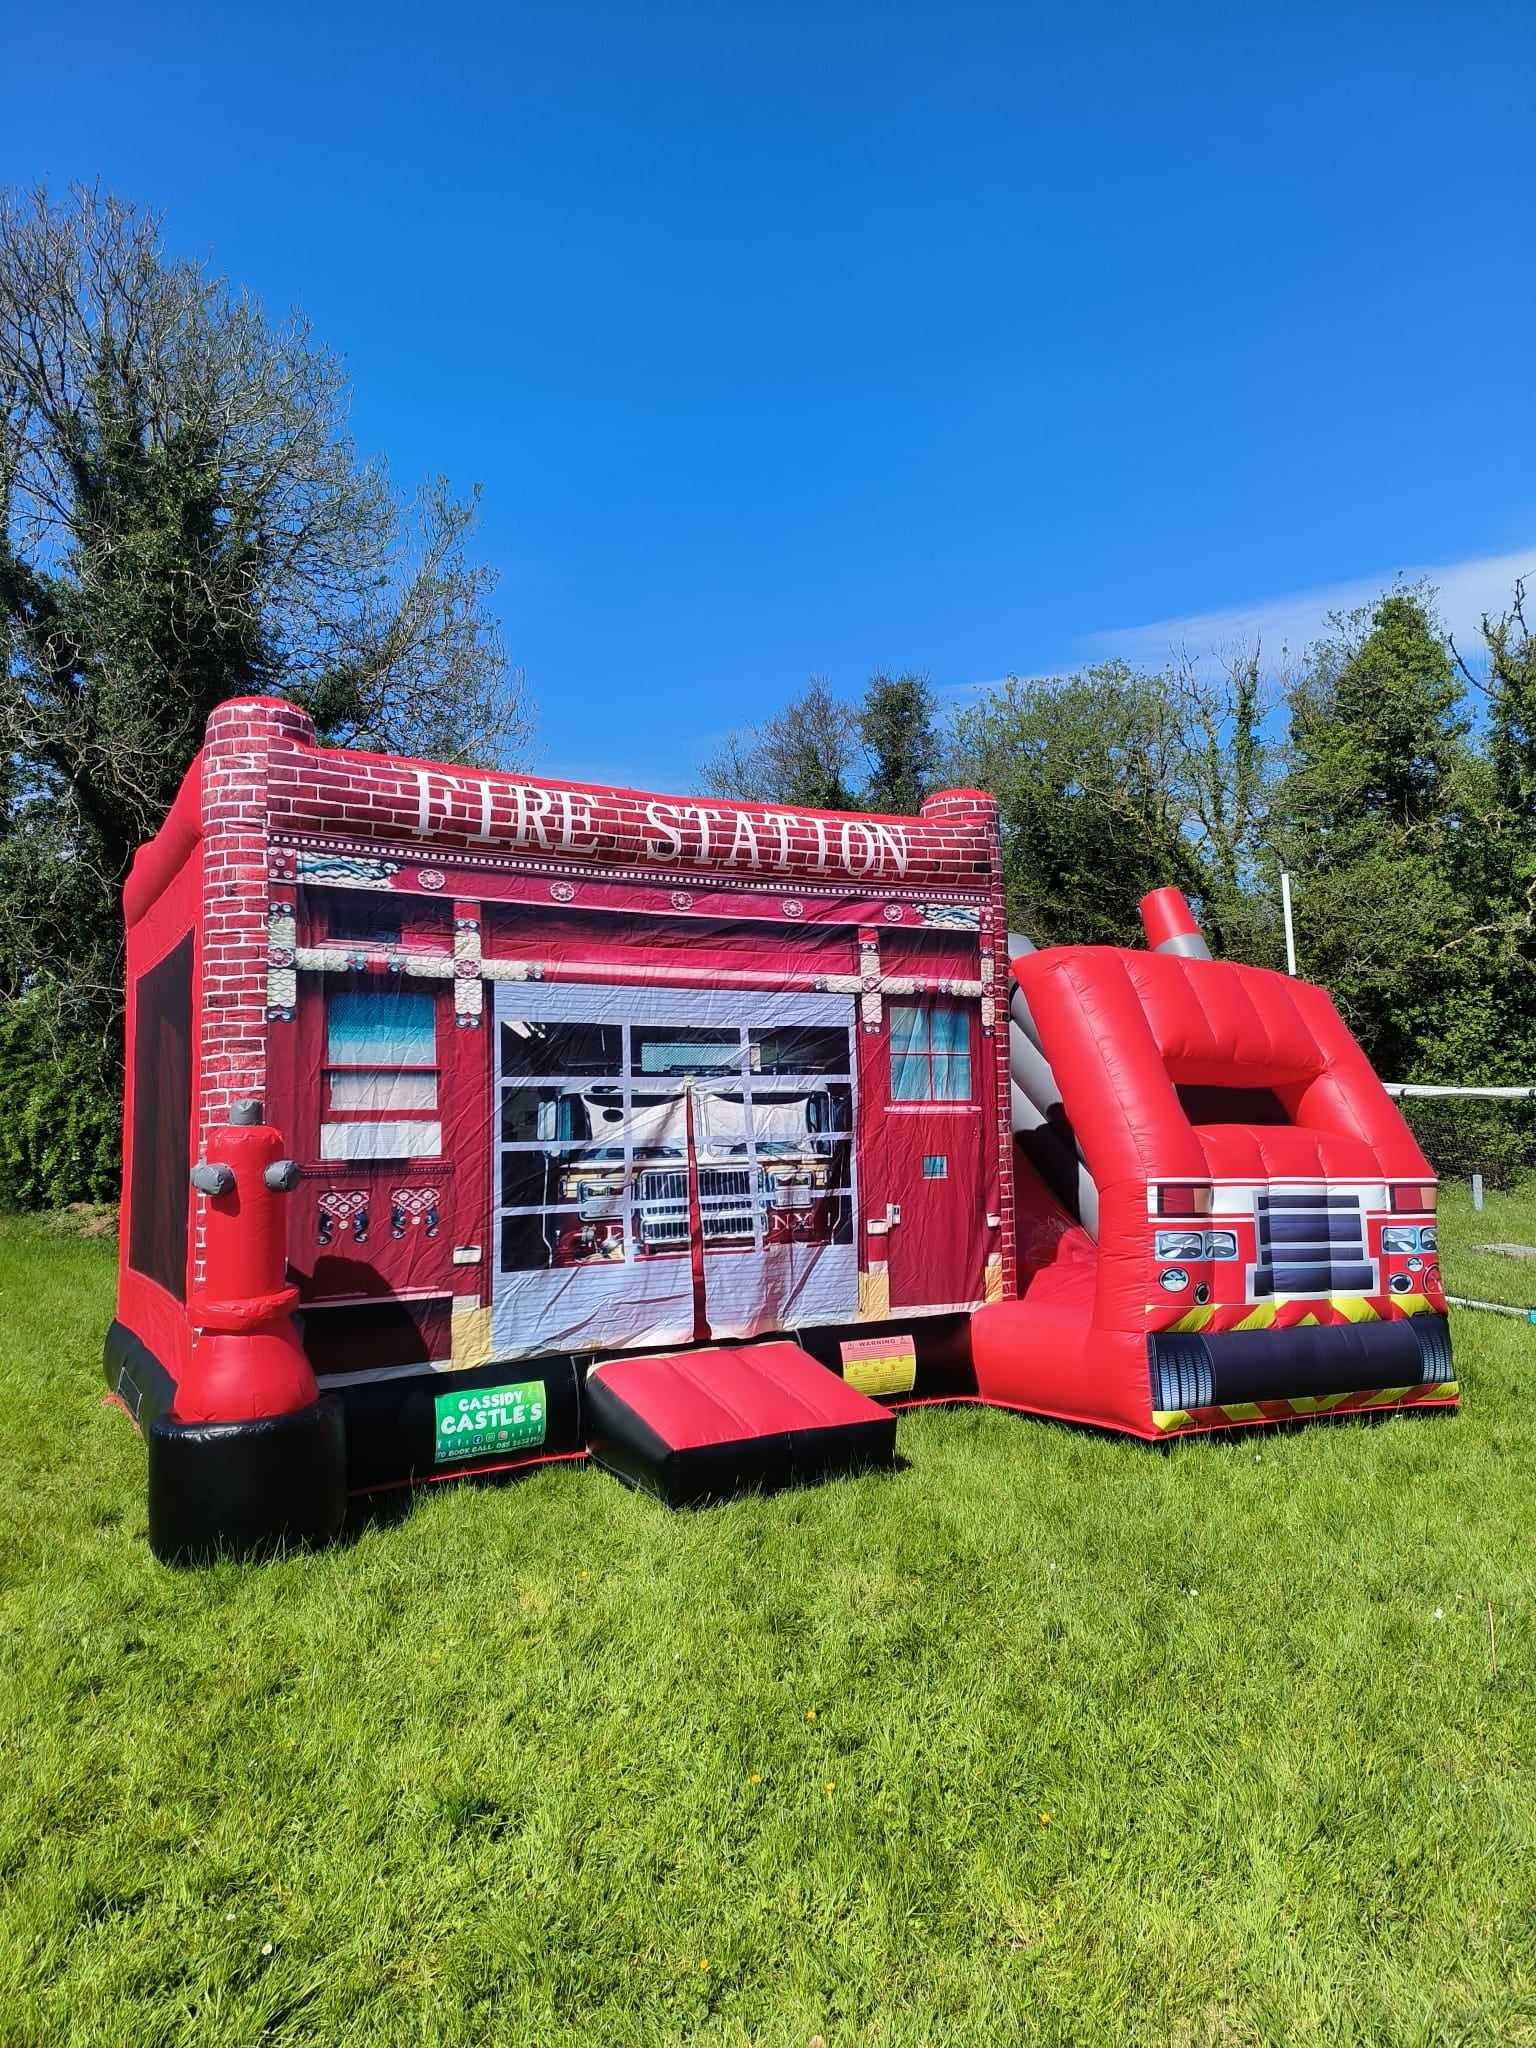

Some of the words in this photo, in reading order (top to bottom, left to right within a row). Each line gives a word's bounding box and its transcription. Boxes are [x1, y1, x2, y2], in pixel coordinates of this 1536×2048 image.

[412, 770, 599, 853] FIRE
[646, 802, 908, 878] STATION
[859, 1338, 896, 1347] WARNING
[458, 1391, 523, 1412] CASSIDY
[440, 1403, 542, 1434] CASTLE'S
[437, 1450, 446, 1458] TO
[449, 1447, 471, 1457] BOOK
